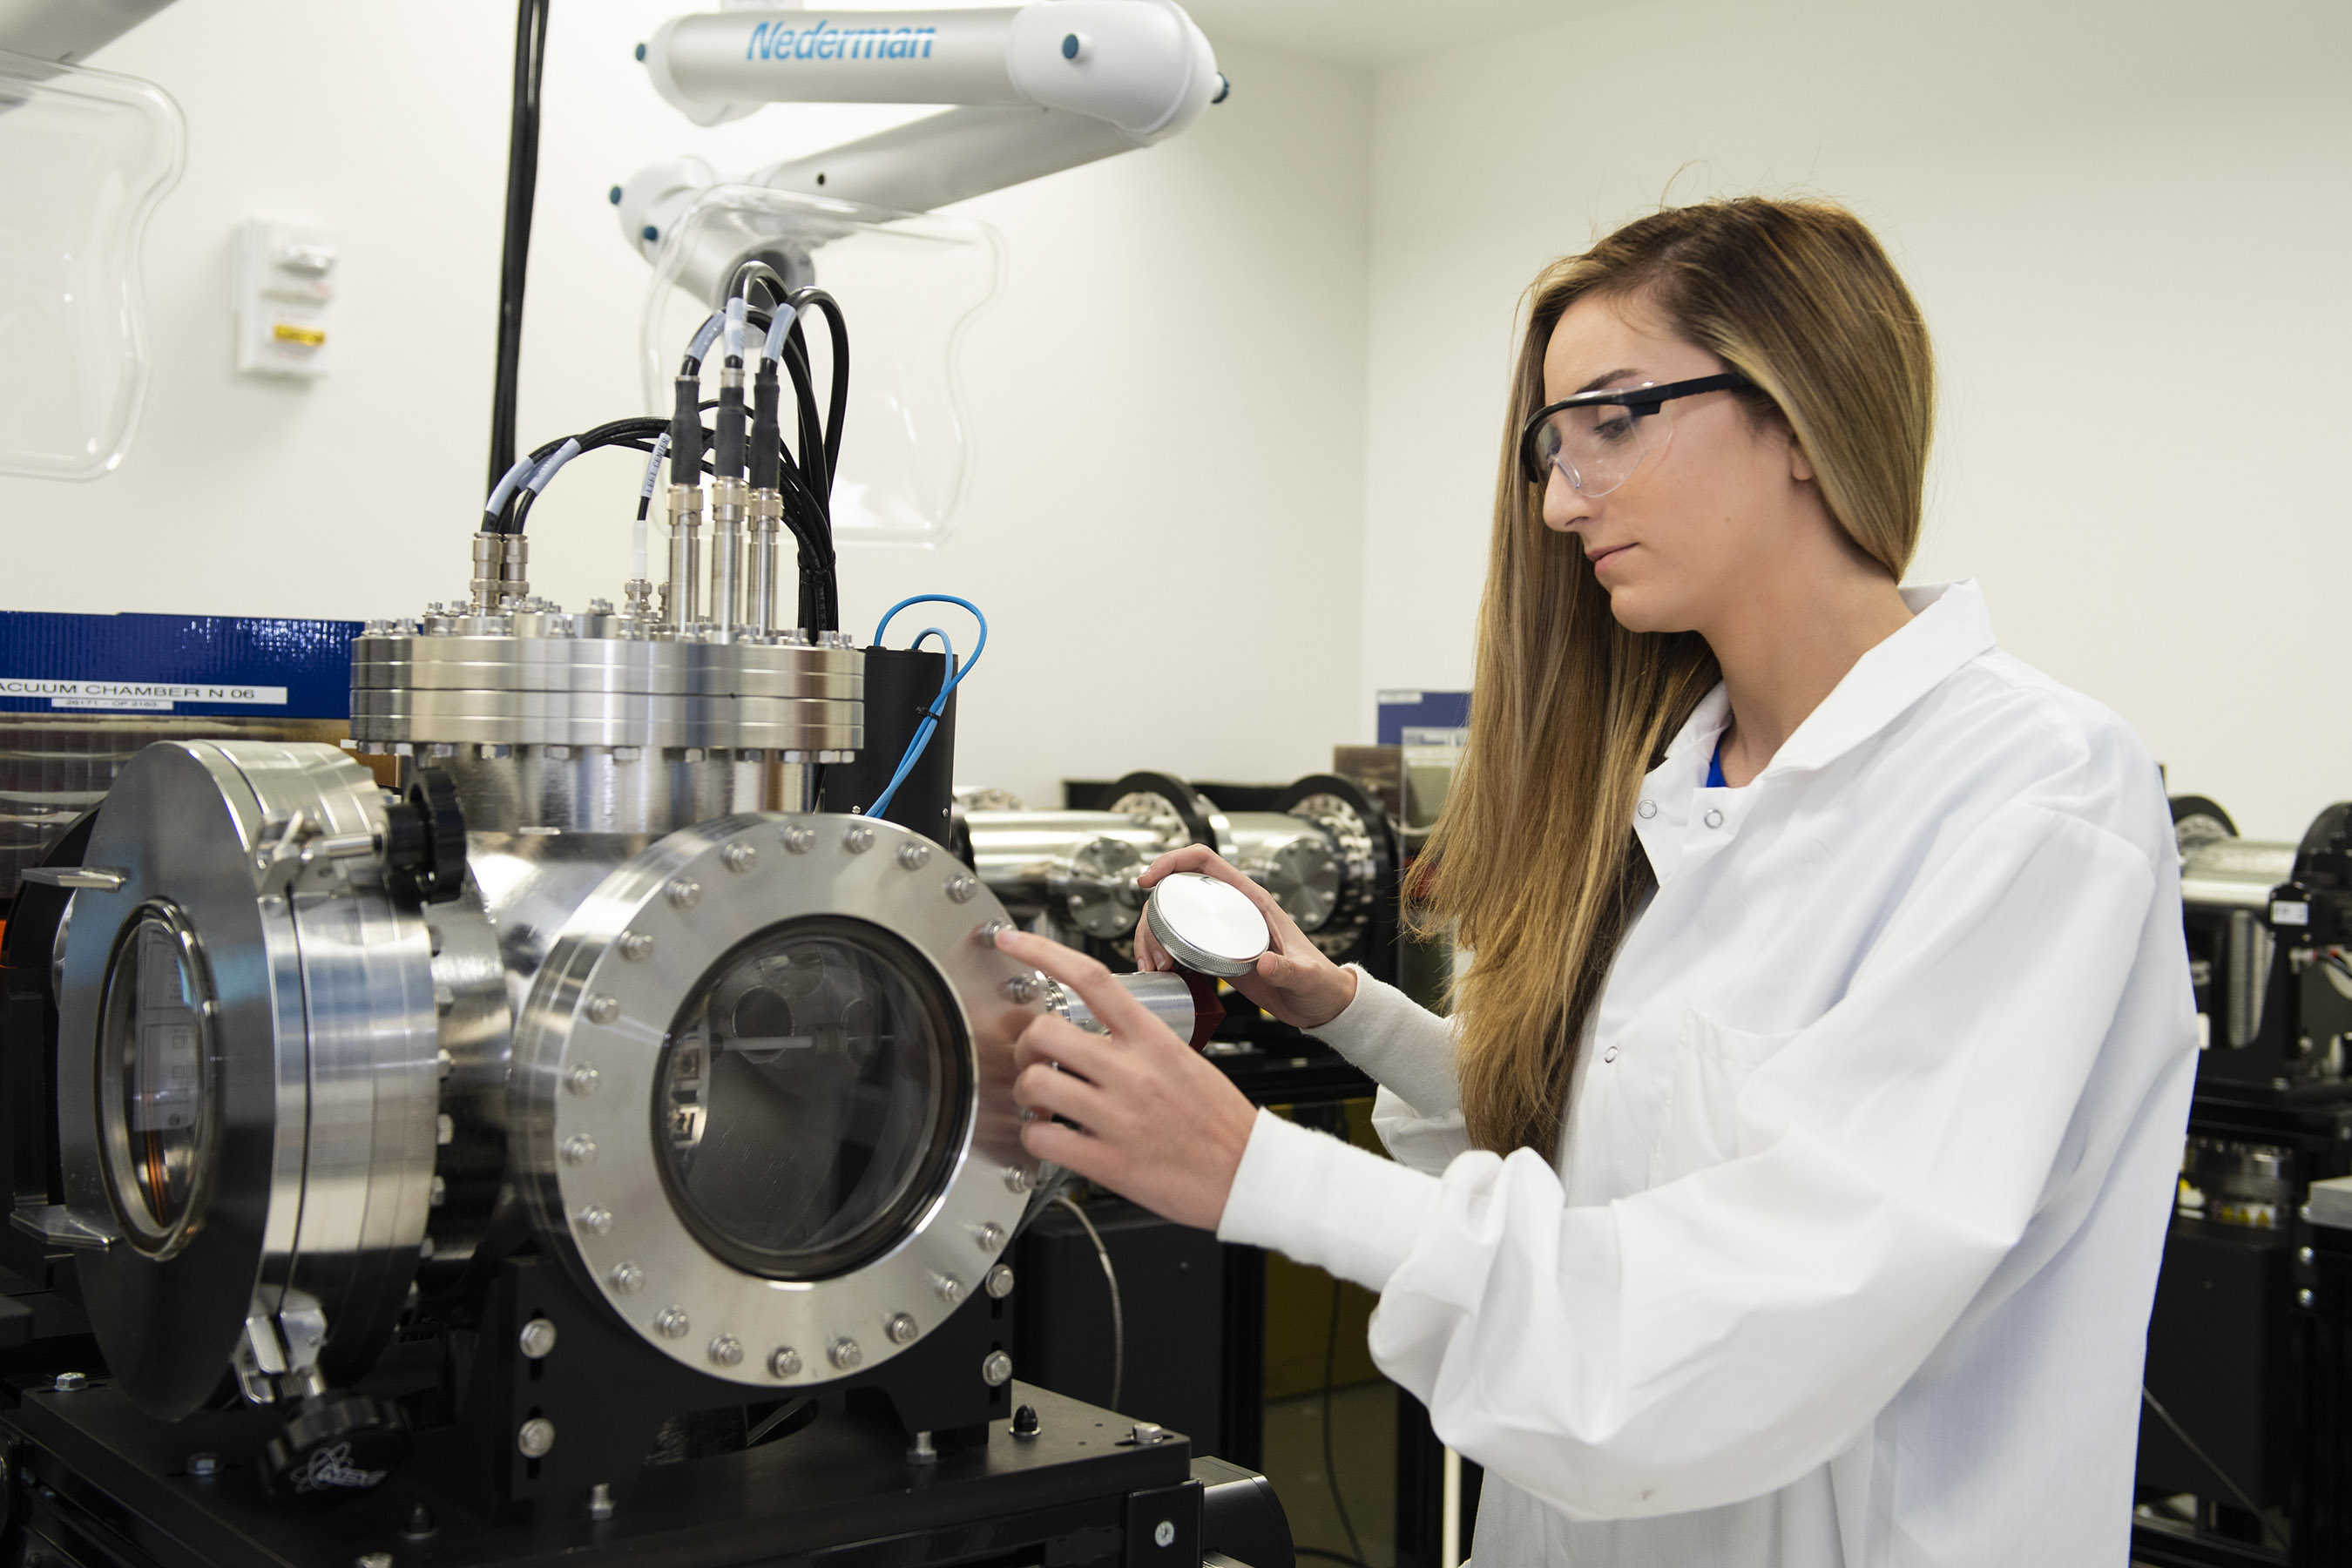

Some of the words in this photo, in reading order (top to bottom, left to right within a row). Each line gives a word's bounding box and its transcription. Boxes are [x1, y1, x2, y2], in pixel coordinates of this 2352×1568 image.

[747, 20, 936, 61] Nederman
[652, 437, 670, 468] CENTER
[84, 684, 200, 697] CHAMBER
[208, 688, 224, 698] N
[230, 689, 255, 699] 06
